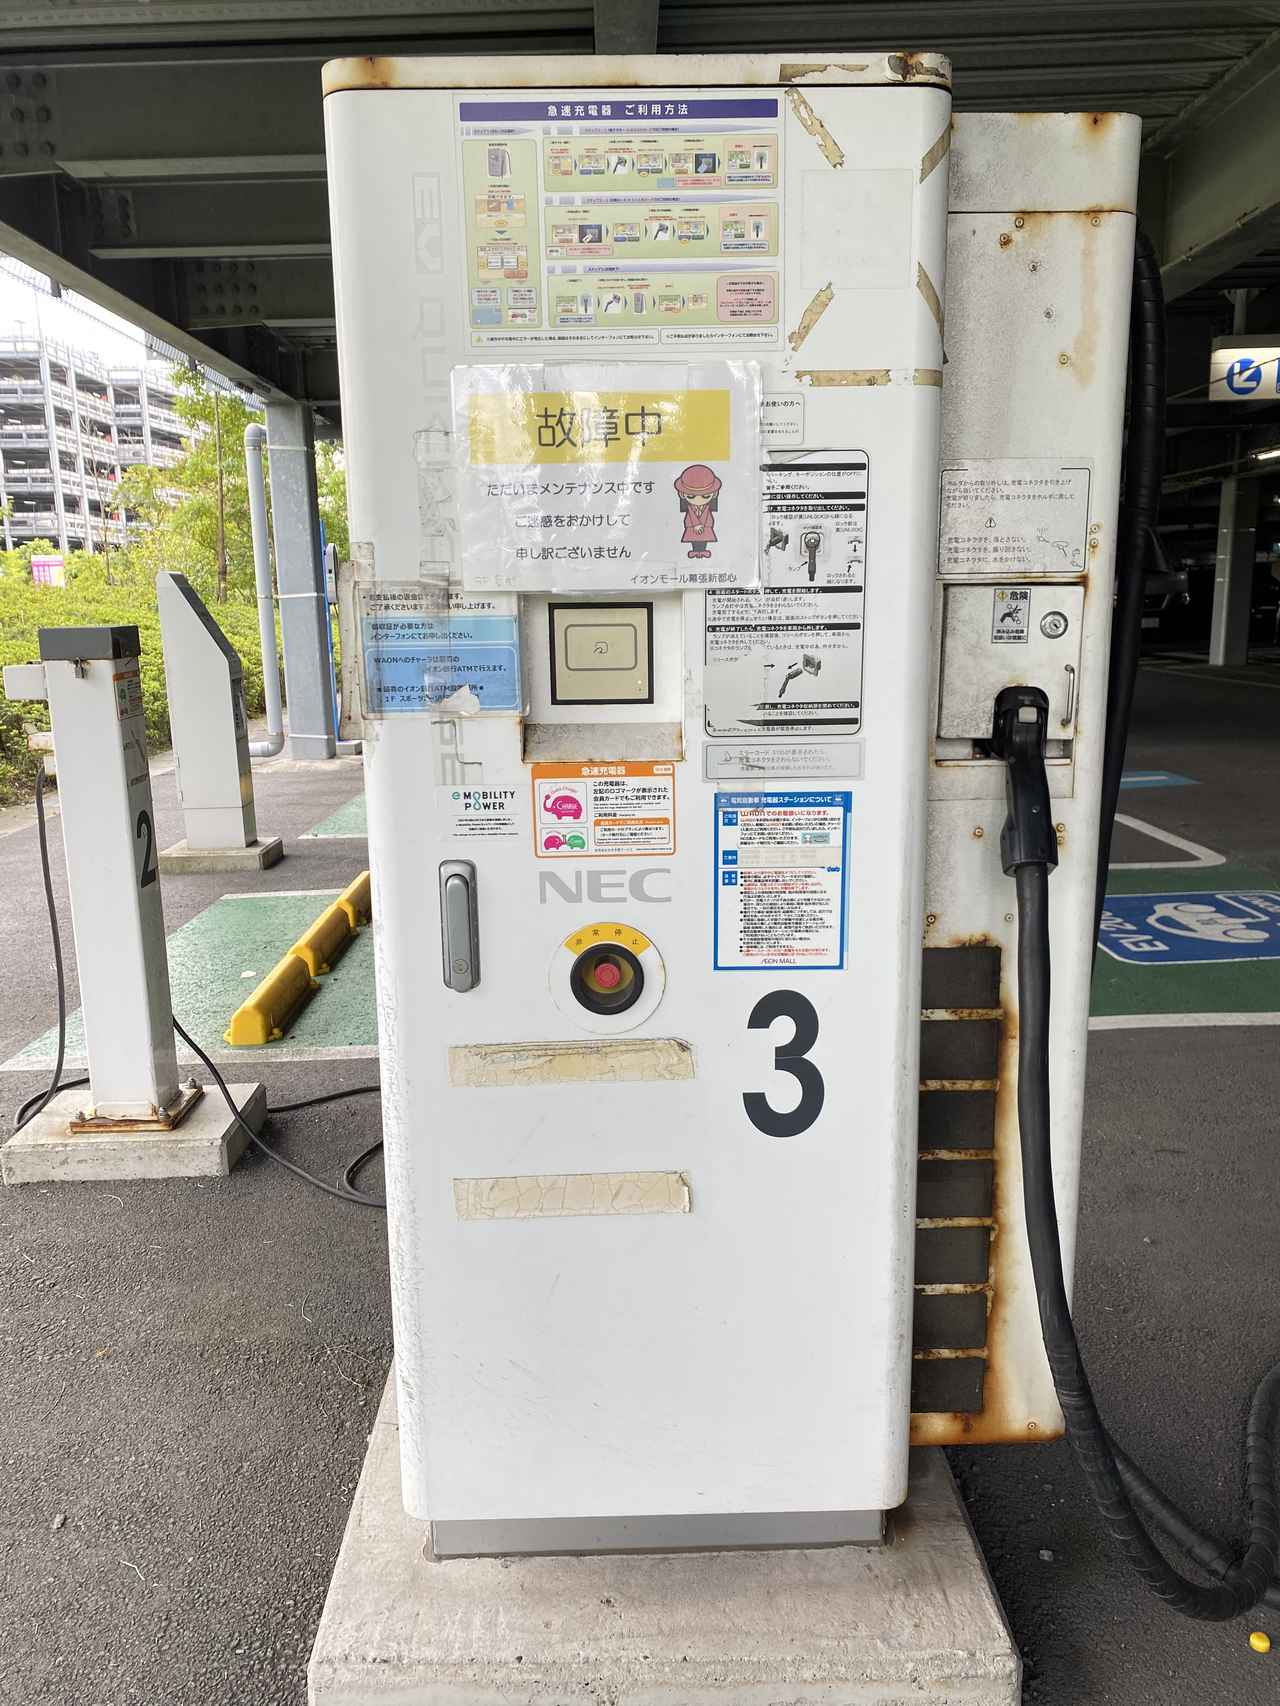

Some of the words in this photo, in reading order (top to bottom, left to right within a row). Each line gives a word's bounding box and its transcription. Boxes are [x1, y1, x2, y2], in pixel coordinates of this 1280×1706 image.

[547, 104, 612, 116] 急速充電器
[624, 103, 689, 115] ご利用方法
[535, 405, 663, 448] 故障中
[487, 480, 655, 497] ただいまメンテナンス中です
[516, 547, 632, 560] 申し訳ございません
[631, 572, 737, 584] イオンモール幕張新都心
[1009, 590, 1029, 601] 危険
[581, 767, 626, 776] 急速充電器
[593, 787, 669, 795] 左記のロゴマークが表示された
[593, 794, 671, 802] 会員カードでもご利用できます。
[136, 809, 157, 889] 2
[539, 867, 673, 905] NEC
[1109, 932, 1170, 952] EV
[742, 989, 826, 1138] 3
